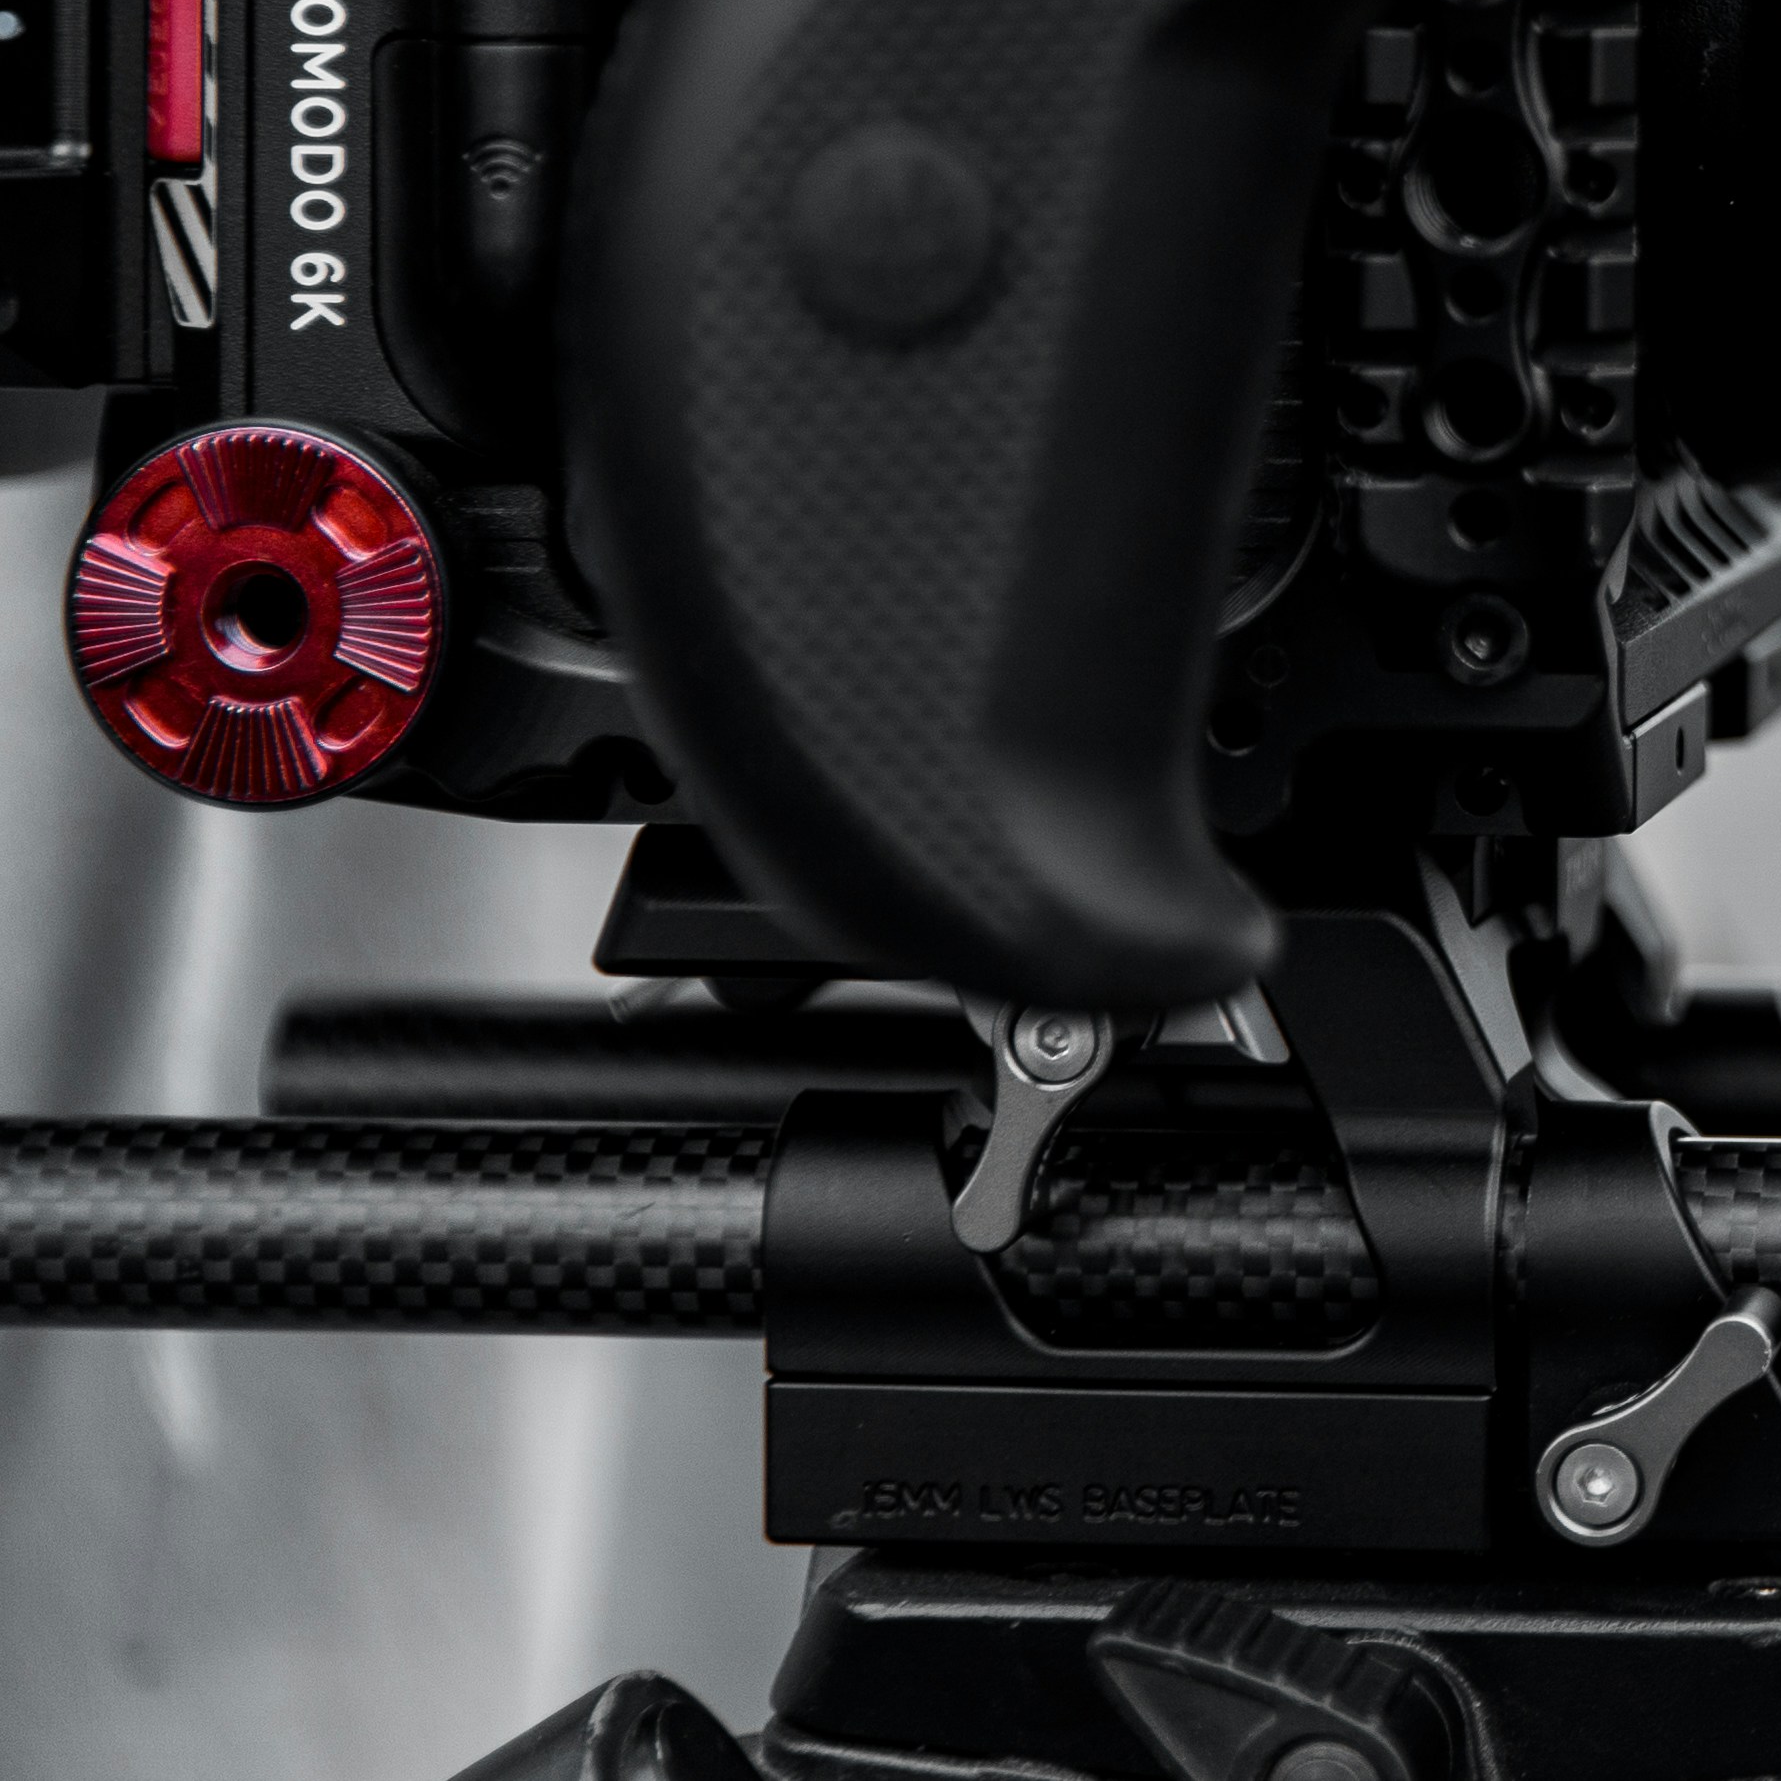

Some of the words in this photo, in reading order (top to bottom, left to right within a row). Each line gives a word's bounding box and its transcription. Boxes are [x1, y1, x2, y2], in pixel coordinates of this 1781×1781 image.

[290, 252, 346, 331] 6K
[979, 1482, 1062, 1523] LWS
[1083, 1483, 1302, 1528] BASEPLATE
